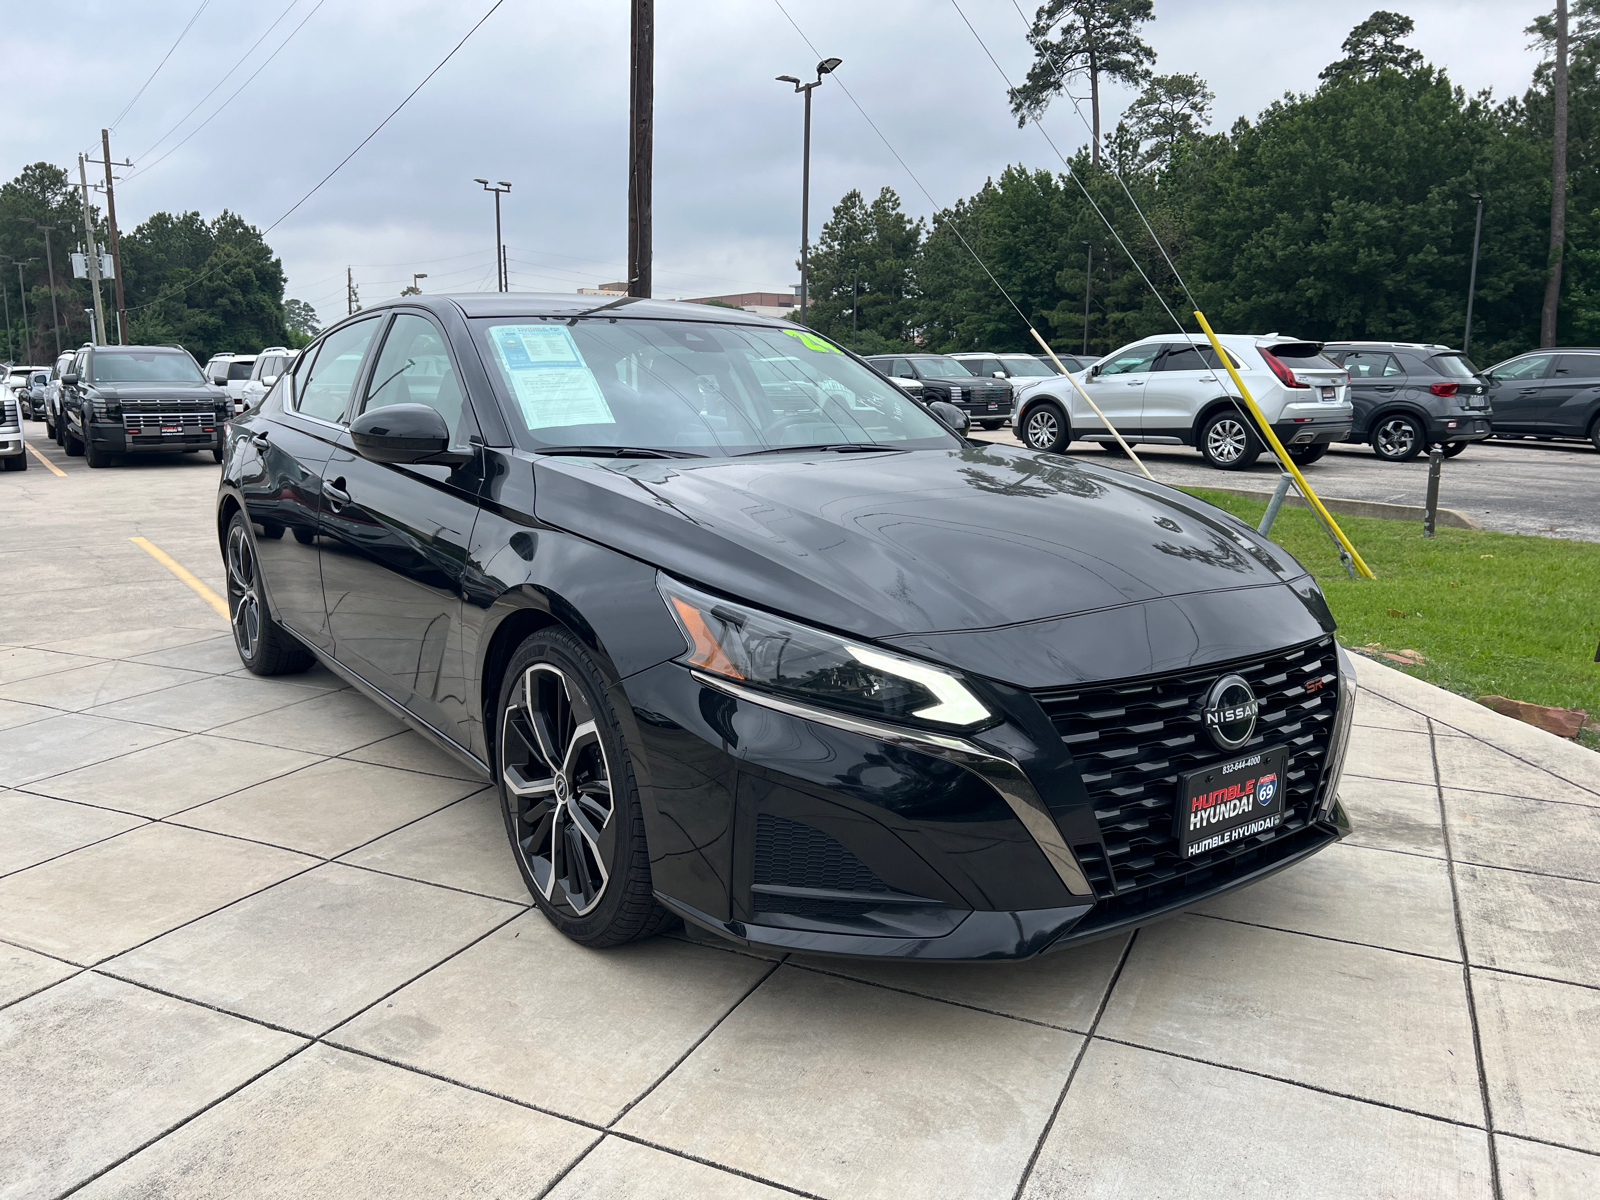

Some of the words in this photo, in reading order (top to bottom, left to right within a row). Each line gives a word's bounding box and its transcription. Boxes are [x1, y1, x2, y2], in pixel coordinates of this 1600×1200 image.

[1306, 677, 1323, 694] SR
[1207, 702, 1258, 724] NISSAN
[1222, 756, 1261, 775] 832-644-4000
[1192, 779, 1255, 812] HUMBLE
[1260, 784, 1273, 801] 69
[1189, 794, 1253, 831] HYUNDAI
[1188, 832, 1231, 857] HUMBLE
[1231, 817, 1274, 841] HYUNDAI
